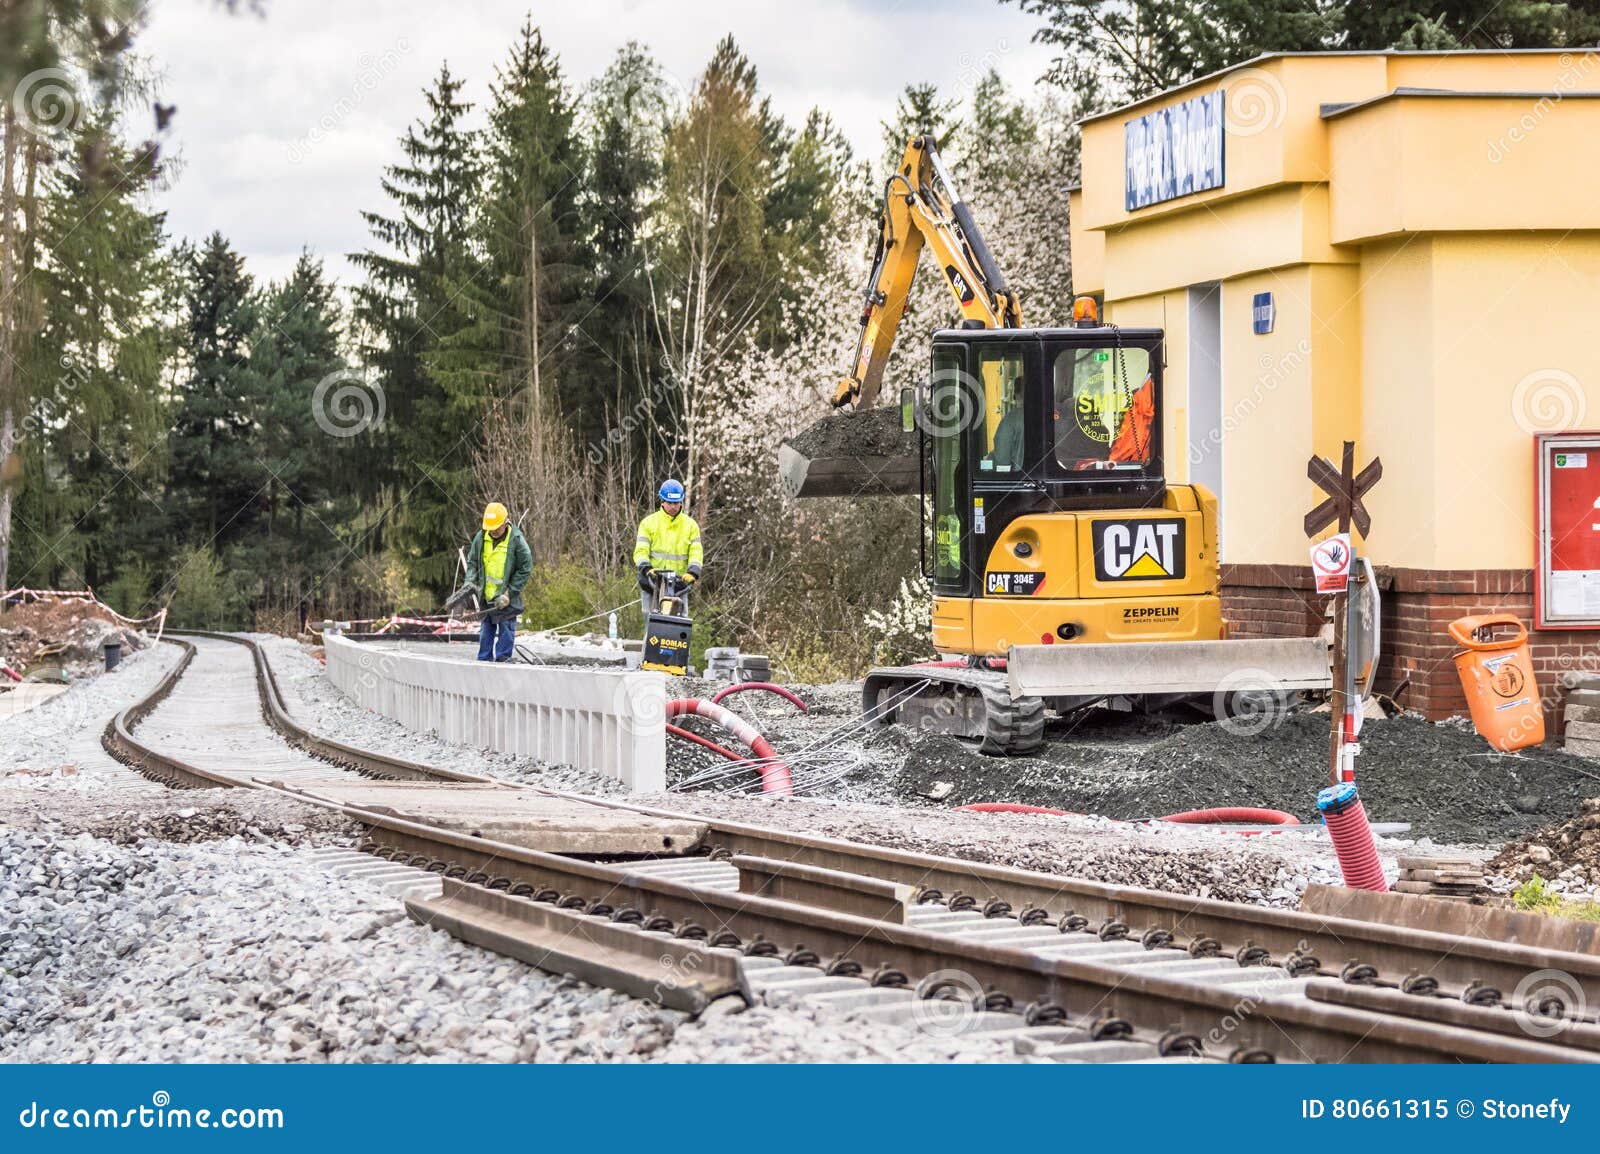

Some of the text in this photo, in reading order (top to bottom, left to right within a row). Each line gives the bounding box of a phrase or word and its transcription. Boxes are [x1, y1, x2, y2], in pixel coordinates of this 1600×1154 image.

[953, 272, 967, 300] CAT
[1103, 523, 1178, 578] CAT
[988, 573, 1011, 593] CAT
[1013, 573, 1034, 584] 304E
[1123, 607, 1179, 618] ZEPPELIN
[661, 639, 687, 648] BOMAG
